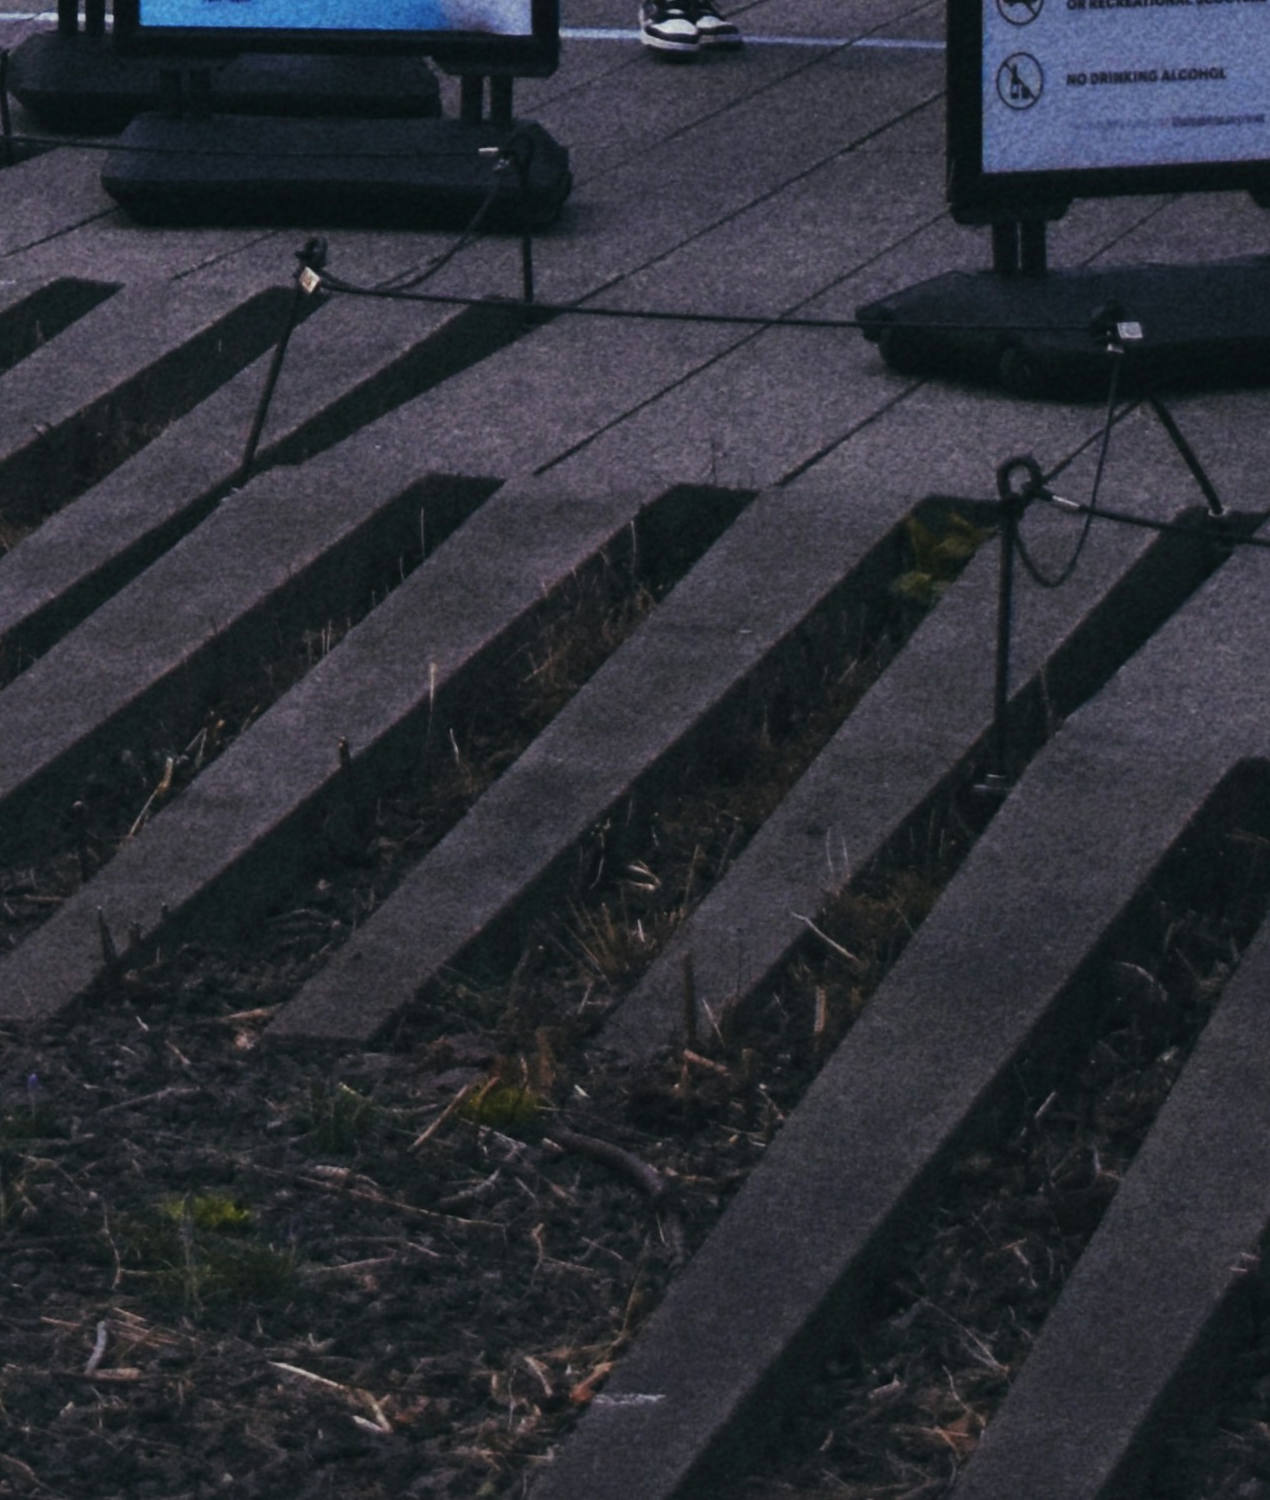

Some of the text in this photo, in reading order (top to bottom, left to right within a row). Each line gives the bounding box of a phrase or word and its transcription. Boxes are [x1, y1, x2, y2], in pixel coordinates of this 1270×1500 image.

[1067, 66, 1227, 86] NO DRINKING ALCOHOL
